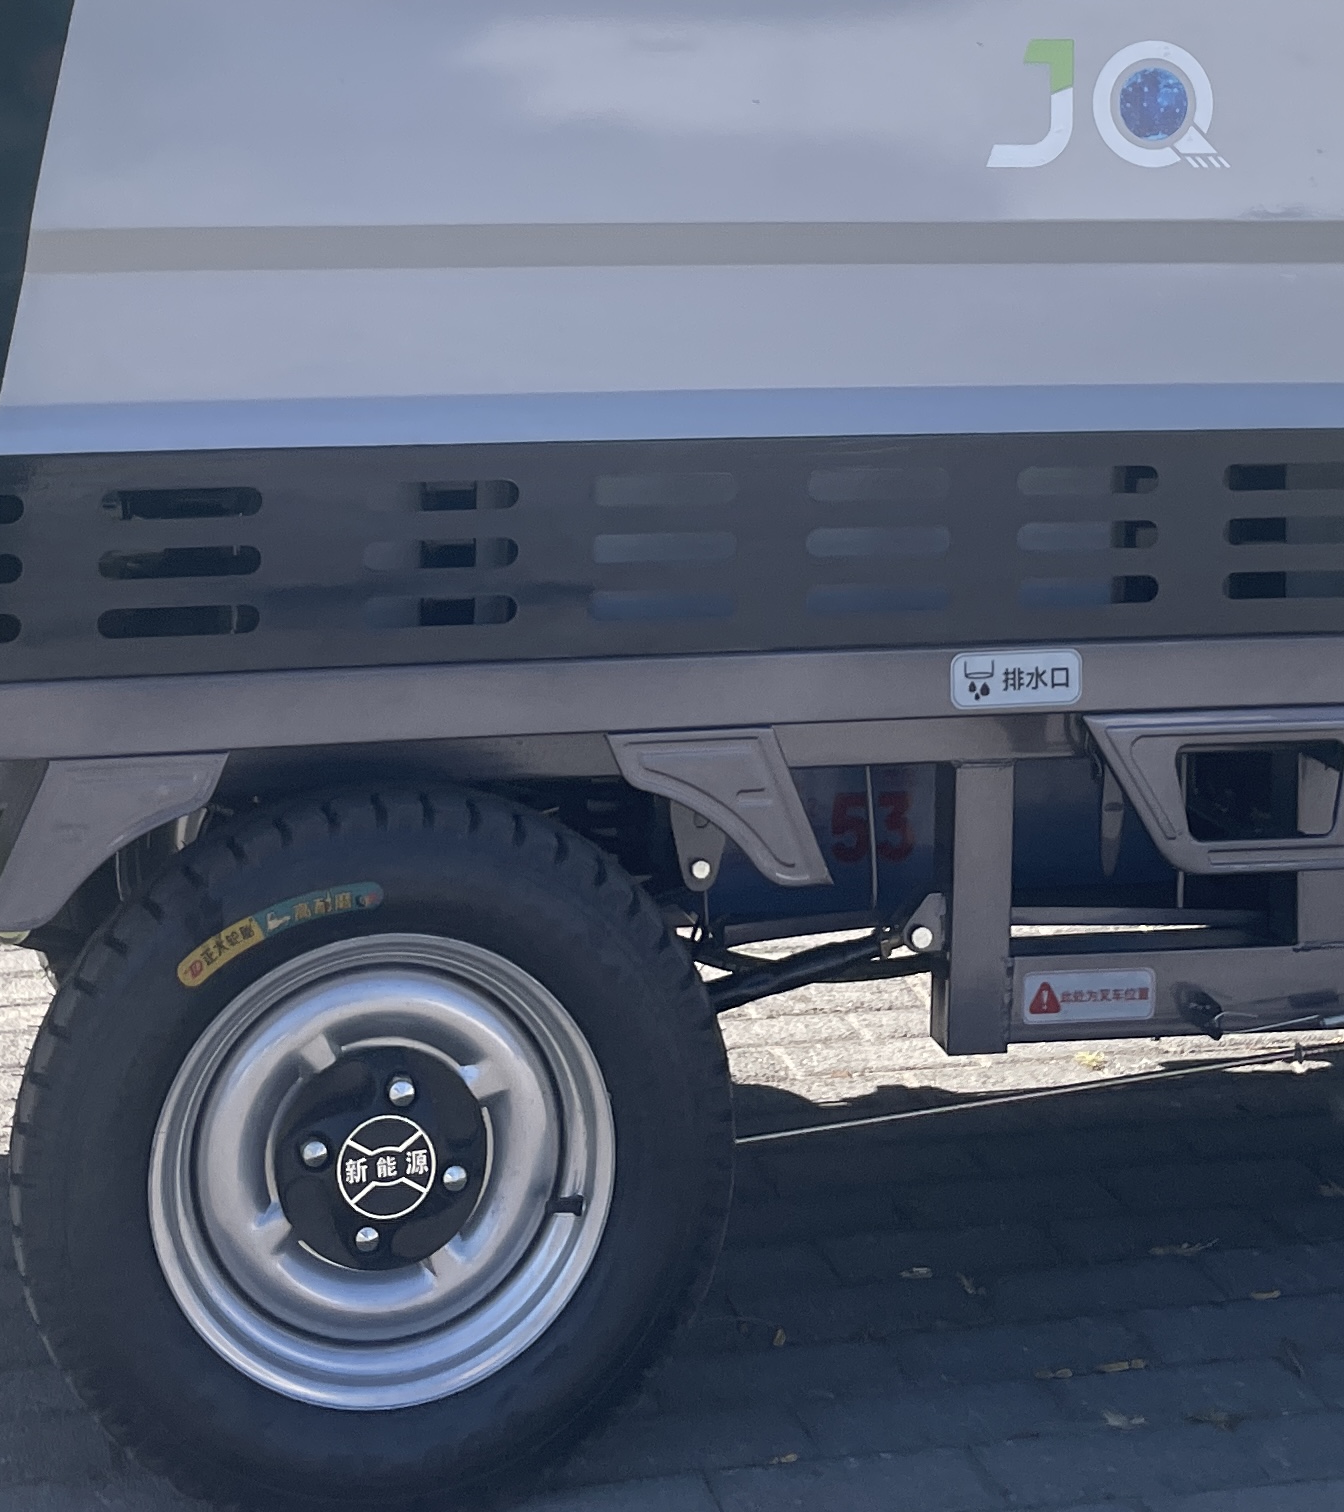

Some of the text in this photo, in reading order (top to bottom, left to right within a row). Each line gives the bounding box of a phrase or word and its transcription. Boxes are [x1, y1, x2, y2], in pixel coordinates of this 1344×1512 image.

[986, 38, 1231, 168] JQ
[1002, 666, 1070, 691] 排水口
[345, 1149, 430, 1184] 新能源
